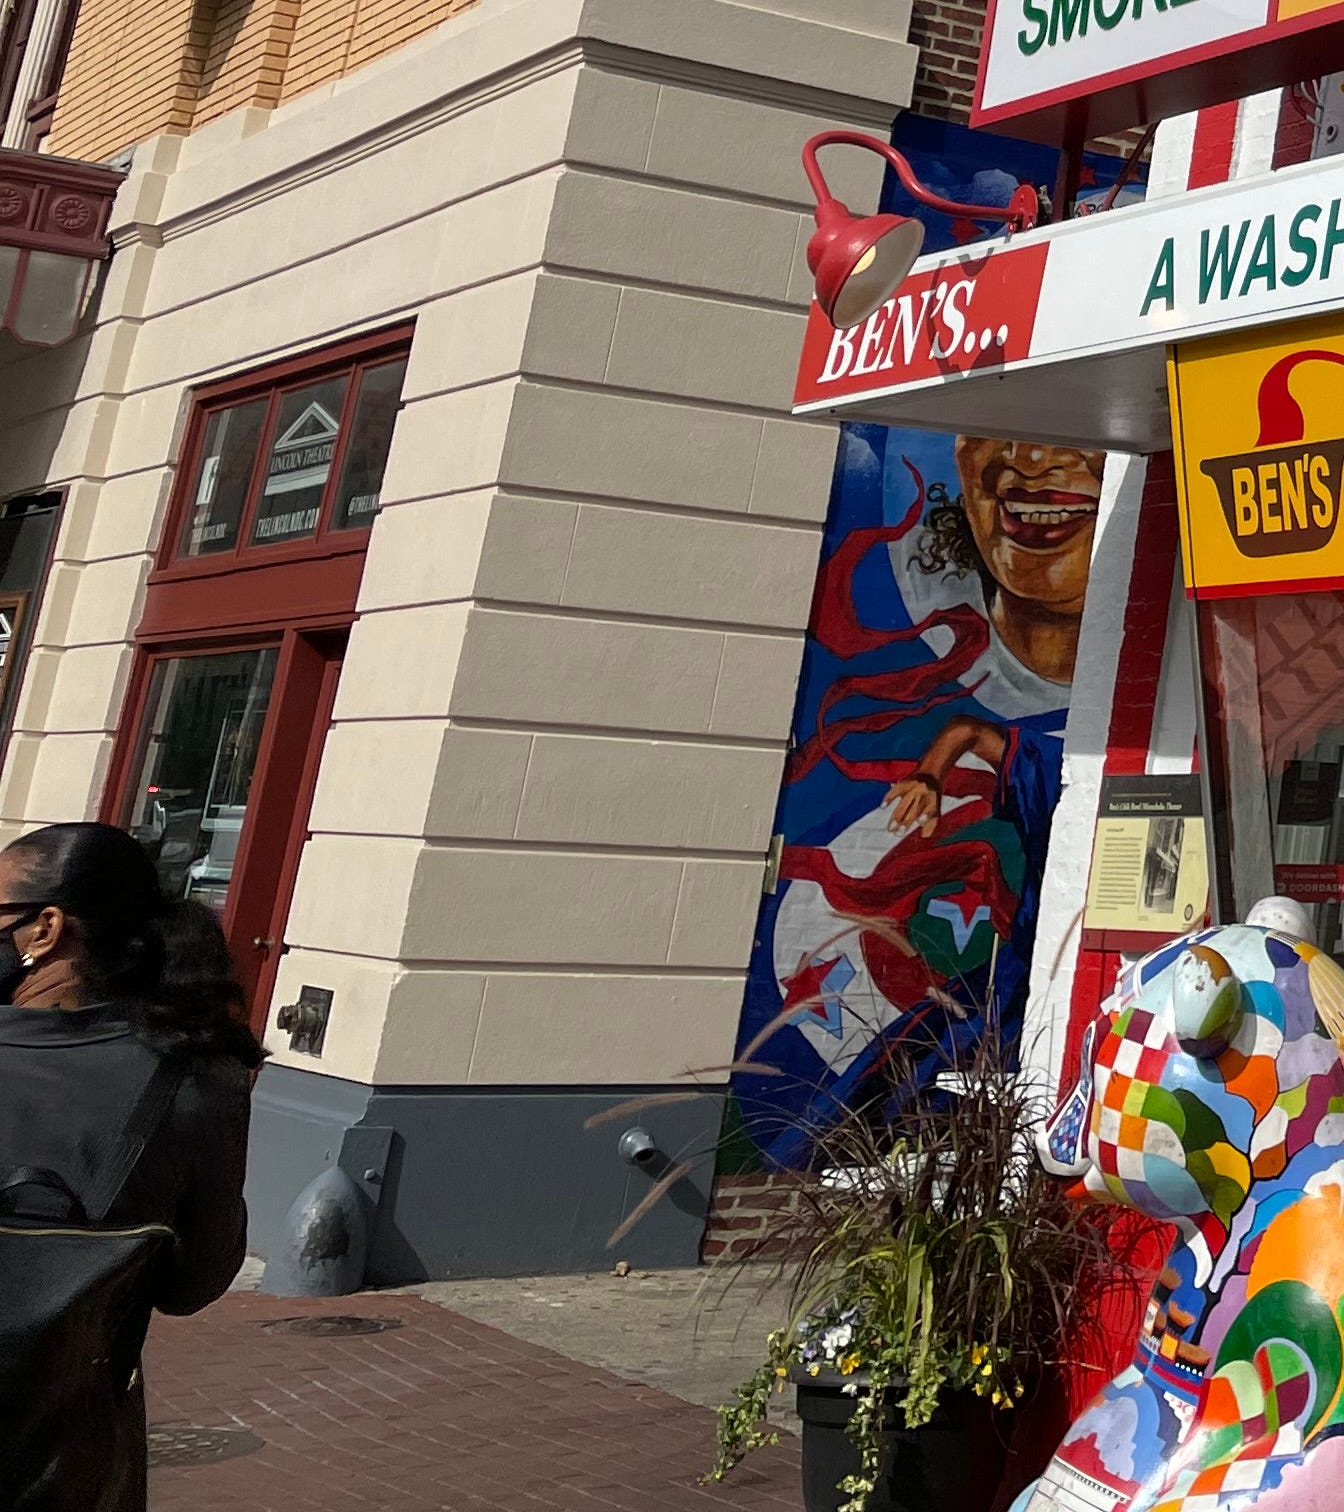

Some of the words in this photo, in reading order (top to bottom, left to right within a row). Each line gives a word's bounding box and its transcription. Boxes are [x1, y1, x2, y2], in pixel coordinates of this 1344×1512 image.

[1140, 236, 1176, 318] A
[1235, 458, 1334, 538] BEN'S
[1289, 882, 1344, 893] DOORDASH
